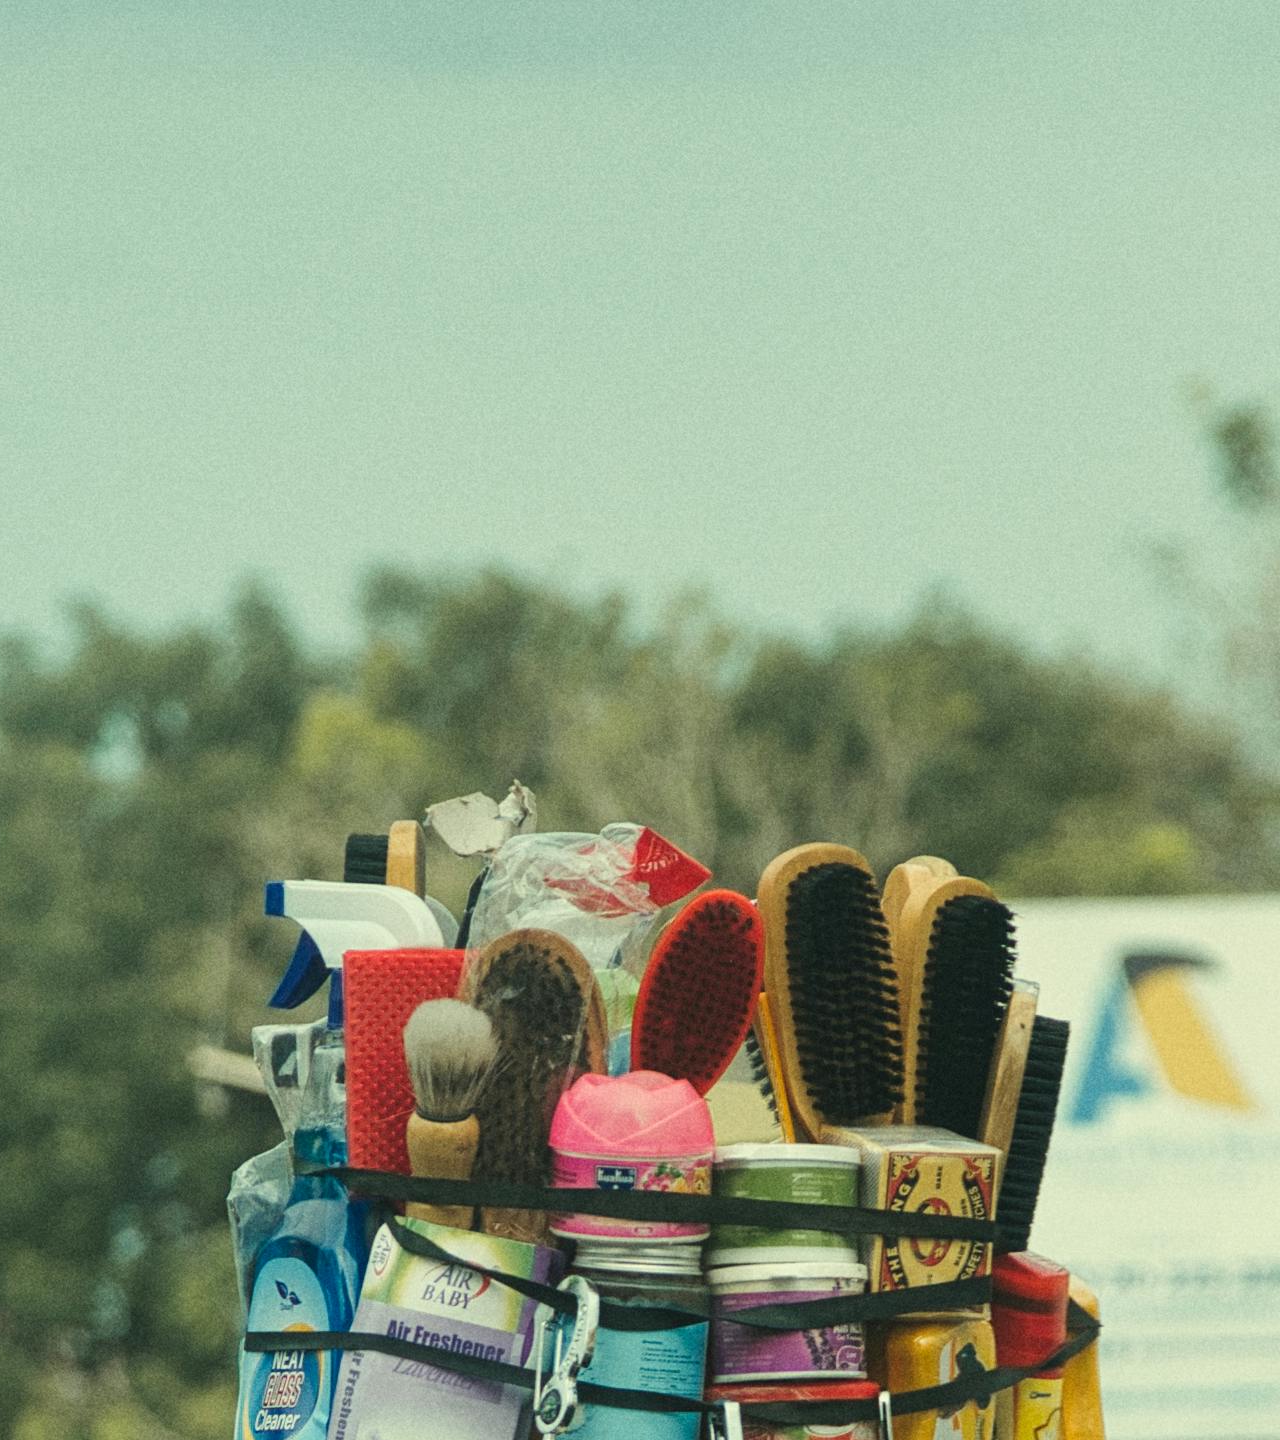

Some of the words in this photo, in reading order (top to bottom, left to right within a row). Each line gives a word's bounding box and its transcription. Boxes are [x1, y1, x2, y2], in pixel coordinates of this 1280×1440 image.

[887, 1246, 907, 1284] THE
[960, 1241, 985, 1280] SAFETY
[434, 1263, 474, 1291] AIR
[421, 1285, 475, 1310] BABY
[386, 1319, 411, 1341] Air
[414, 1325, 506, 1362] Freshener
[272, 1350, 305, 1370] NEAT
[262, 1371, 305, 1409] GLASS
[255, 1410, 302, 1431] Cleaner
